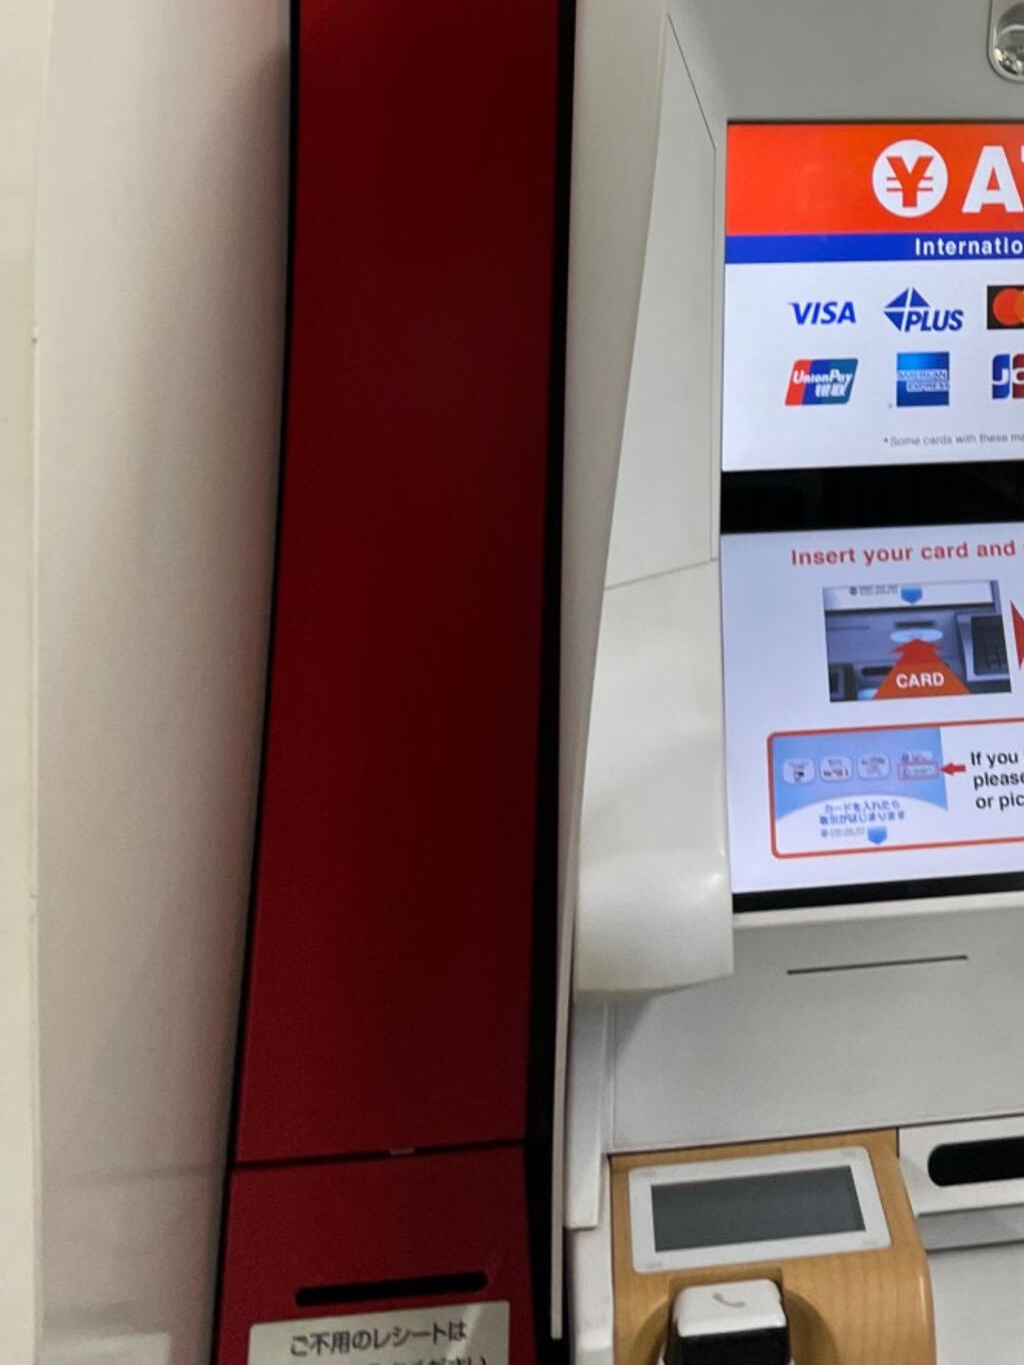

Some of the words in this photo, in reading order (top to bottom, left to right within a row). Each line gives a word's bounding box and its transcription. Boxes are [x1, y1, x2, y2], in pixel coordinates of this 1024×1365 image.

[788, 301, 856, 325] VISA
[904, 309, 964, 332] PLUS
[793, 369, 852, 387] UnionPay
[923, 435, 952, 444] cards
[956, 434, 976, 443] with
[979, 433, 1007, 442] these
[791, 549, 856, 565] Insert
[864, 548, 913, 566] your
[921, 542, 969, 560] card
[977, 540, 1015, 558] and
[896, 672, 945, 688] CARD
[971, 751, 981, 766] If
[987, 753, 1018, 768] you
[976, 796, 994, 809] or
[290, 1319, 467, 1357] ご不用のレシートは
